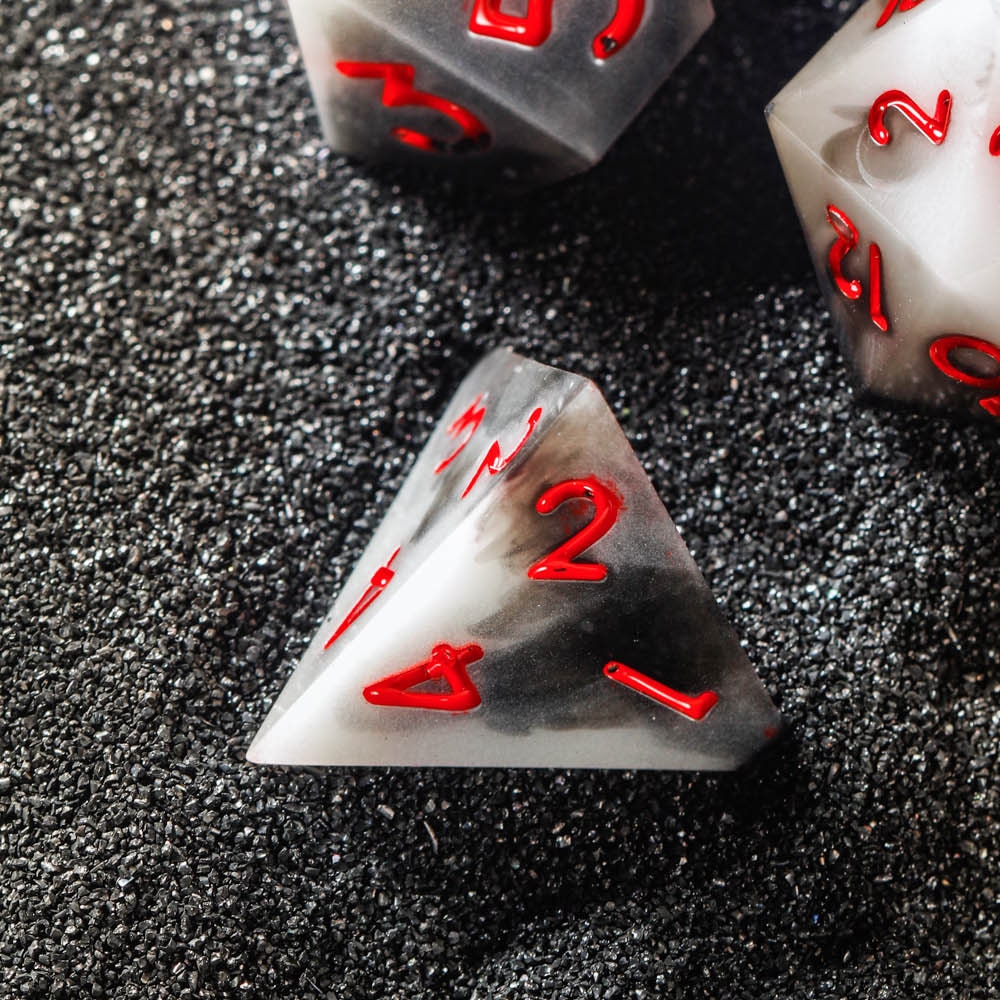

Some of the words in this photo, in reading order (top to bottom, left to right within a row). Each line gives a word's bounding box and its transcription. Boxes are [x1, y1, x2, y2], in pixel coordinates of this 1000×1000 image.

[334, 59, 492, 153] 3
[867, 88, 953, 146] 2
[526, 474, 625, 581] 2
[362, 641, 485, 716] 4
[603, 661, 719, 721] 1
